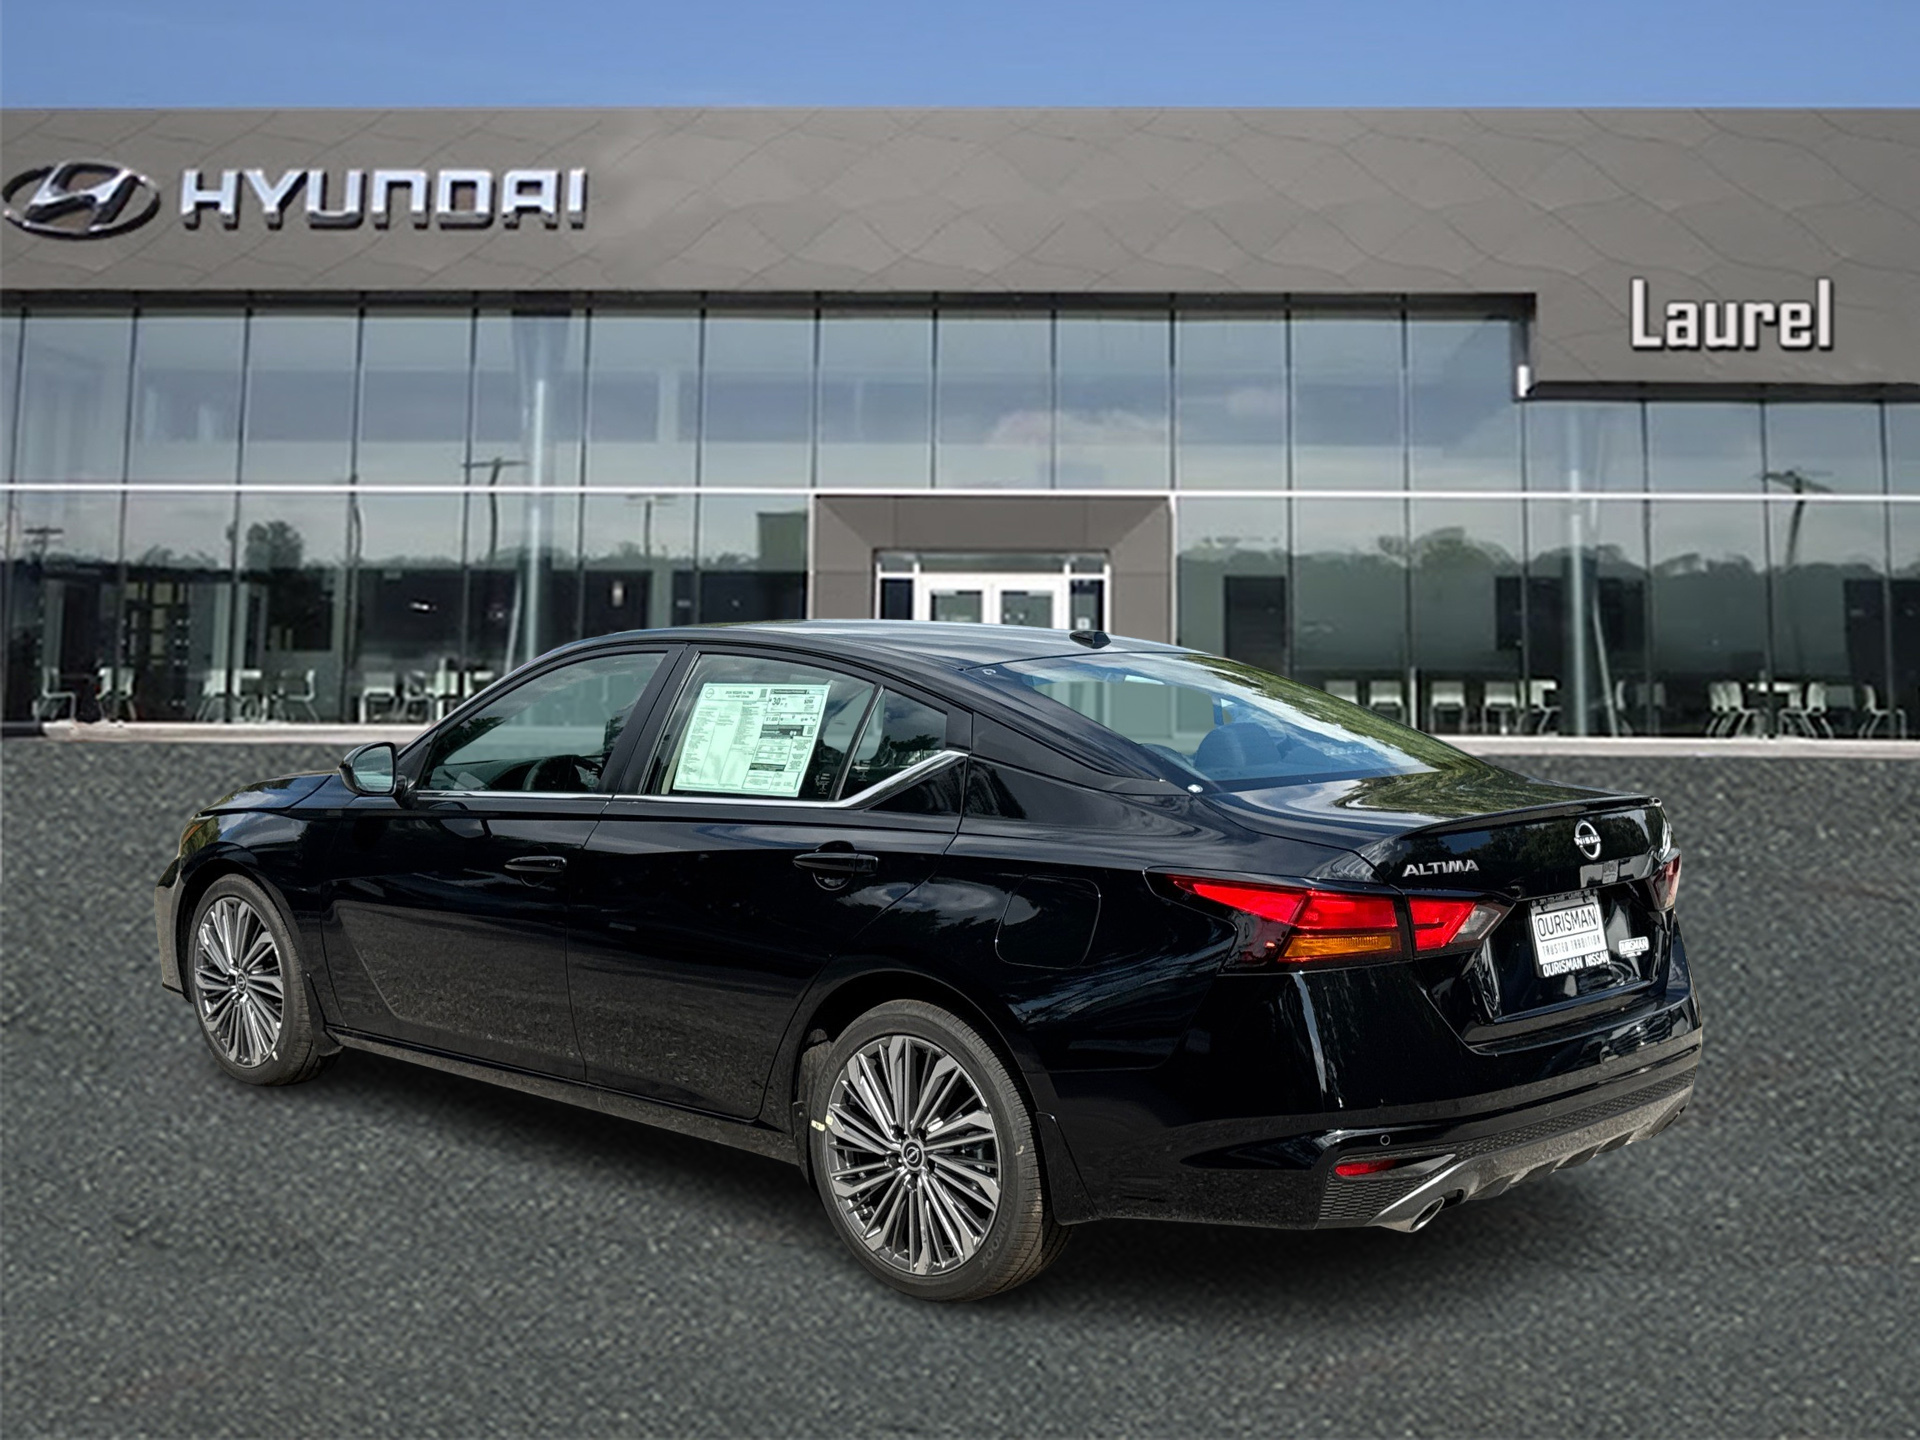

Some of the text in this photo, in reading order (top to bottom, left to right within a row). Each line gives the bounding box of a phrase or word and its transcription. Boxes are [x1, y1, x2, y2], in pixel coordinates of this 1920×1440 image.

[181, 168, 588, 229] HYUNDAI
[1632, 278, 1831, 347] Laurel
[1402, 859, 1480, 877] ALTIMA
[1537, 908, 1597, 937] OURISMAN
[1541, 941, 1569, 957] TRUSTED
[1542, 950, 1611, 977] OURISMAN NISSAN
